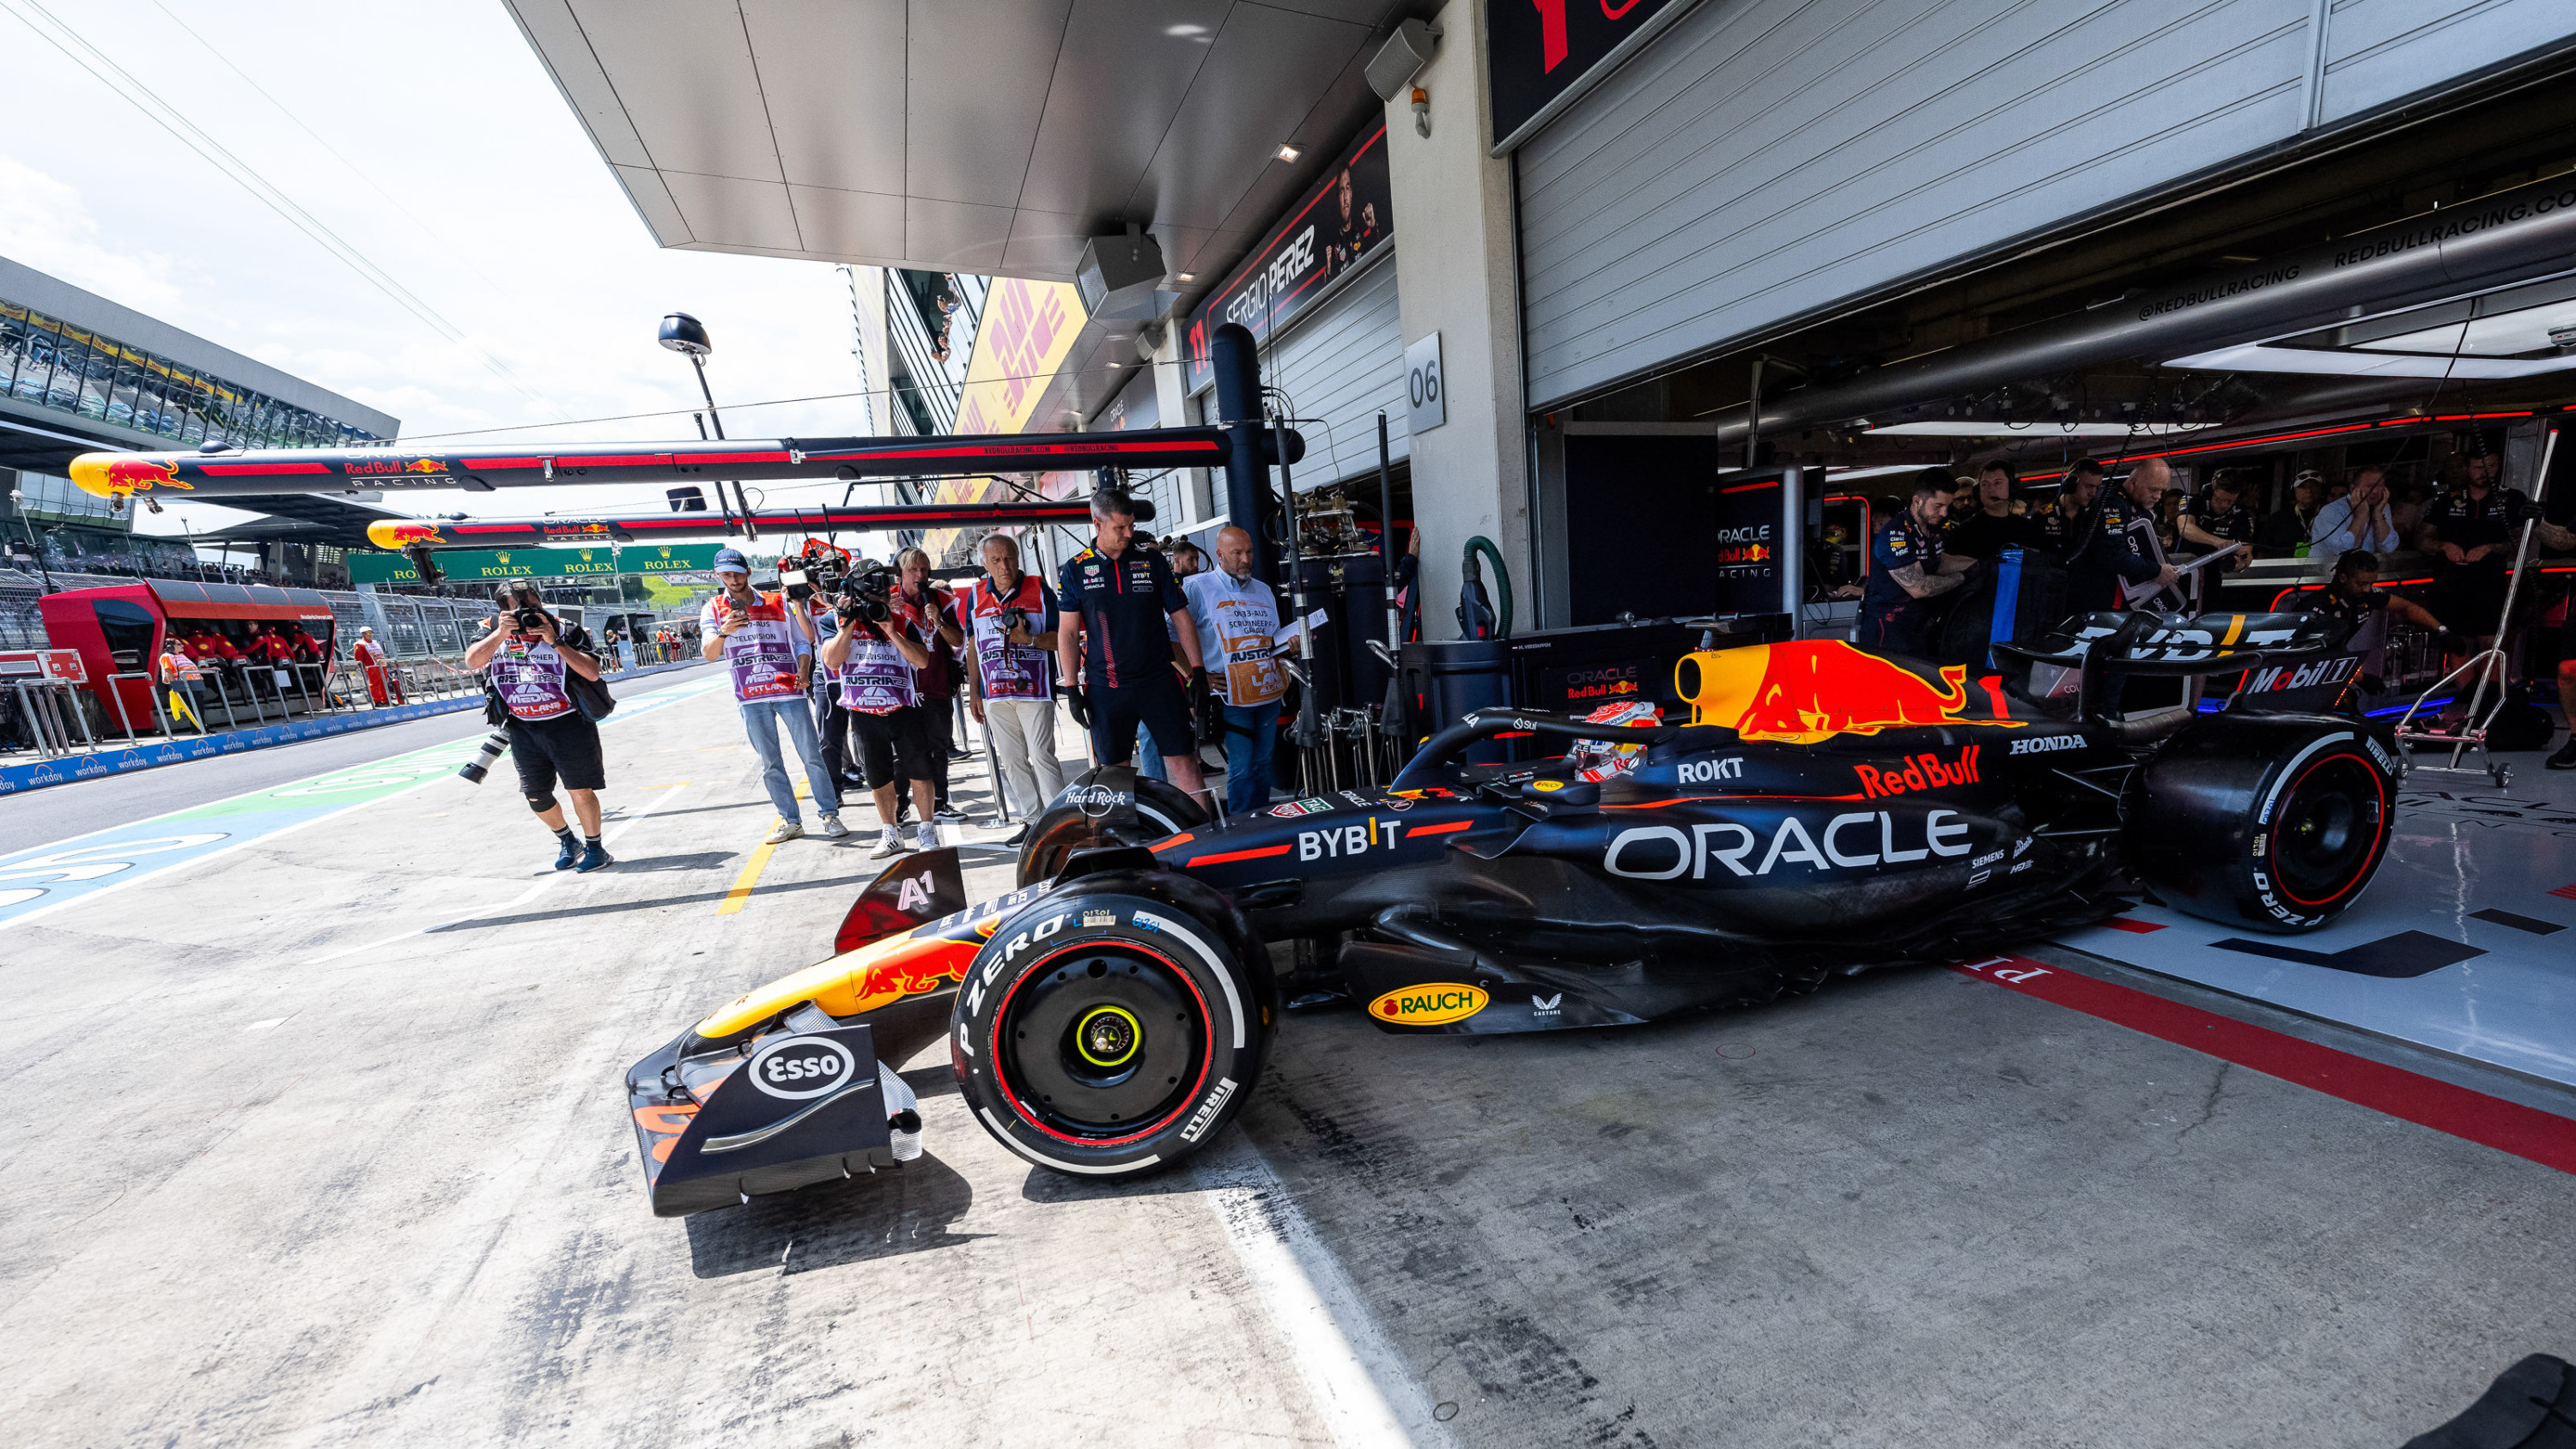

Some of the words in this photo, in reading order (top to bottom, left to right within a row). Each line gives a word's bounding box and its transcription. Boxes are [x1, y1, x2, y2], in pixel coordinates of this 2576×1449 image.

[1227, 273, 1267, 324] SERGIO
[1268, 225, 1315, 300] PEREZ
[2139, 264, 2300, 322] @REDBULLRACING
[1189, 318, 1207, 375] 11
[1411, 360, 1437, 409] 06
[352, 478, 456, 487] RACING
[1718, 525, 1770, 543] RACLE
[482, 565, 532, 576] ROLEX
[565, 562, 614, 573] ROLEX
[644, 560, 692, 570] ROLEX
[1719, 568, 1770, 578] ACING
[735, 634, 776, 643] TELEVISION
[1230, 648, 1272, 664] AUSTR
[1252, 670, 1281, 687] LAN
[1567, 666, 1637, 684] ORACLE
[2247, 662, 2324, 695] Mobil
[748, 684, 763, 694] PIT
[991, 682, 1005, 690] PIT
[507, 692, 556, 704] MEDIA
[855, 696, 901, 706] MEDIA
[1978, 676, 2011, 718] 1
[513, 705, 529, 713] PIT
[1523, 720, 1537, 730] Sui
[223, 741, 244, 751] workday
[252, 736, 272, 746] workday
[2009, 735, 2087, 755] HONDA
[157, 752, 182, 762] workday
[191, 747, 216, 757] workday
[76, 764, 106, 778] workday
[118, 758, 147, 770] workday
[1678, 757, 1743, 784] ROKT
[28, 771, 64, 786] workday
[1066, 791, 1096, 803] Hard
[1097, 791, 1126, 806] Rock
[1305, 798, 1327, 811] TAG
[1339, 791, 1372, 808] ORACLE
[1298, 817, 1401, 861] BYBIT
[1604, 809, 1972, 880] ORACLE
[1971, 849, 2004, 869] SIEMENS
[2253, 872, 2306, 925] ZERO
[1082, 909, 1110, 919] 01301
[967, 914, 1064, 1017] ZERO
[1953, 955, 2053, 984] PI
[1400, 991, 1473, 1014] RAUCH
[961, 1023, 974, 1057] P
[1180, 1076, 1239, 1143] PIRELLI
